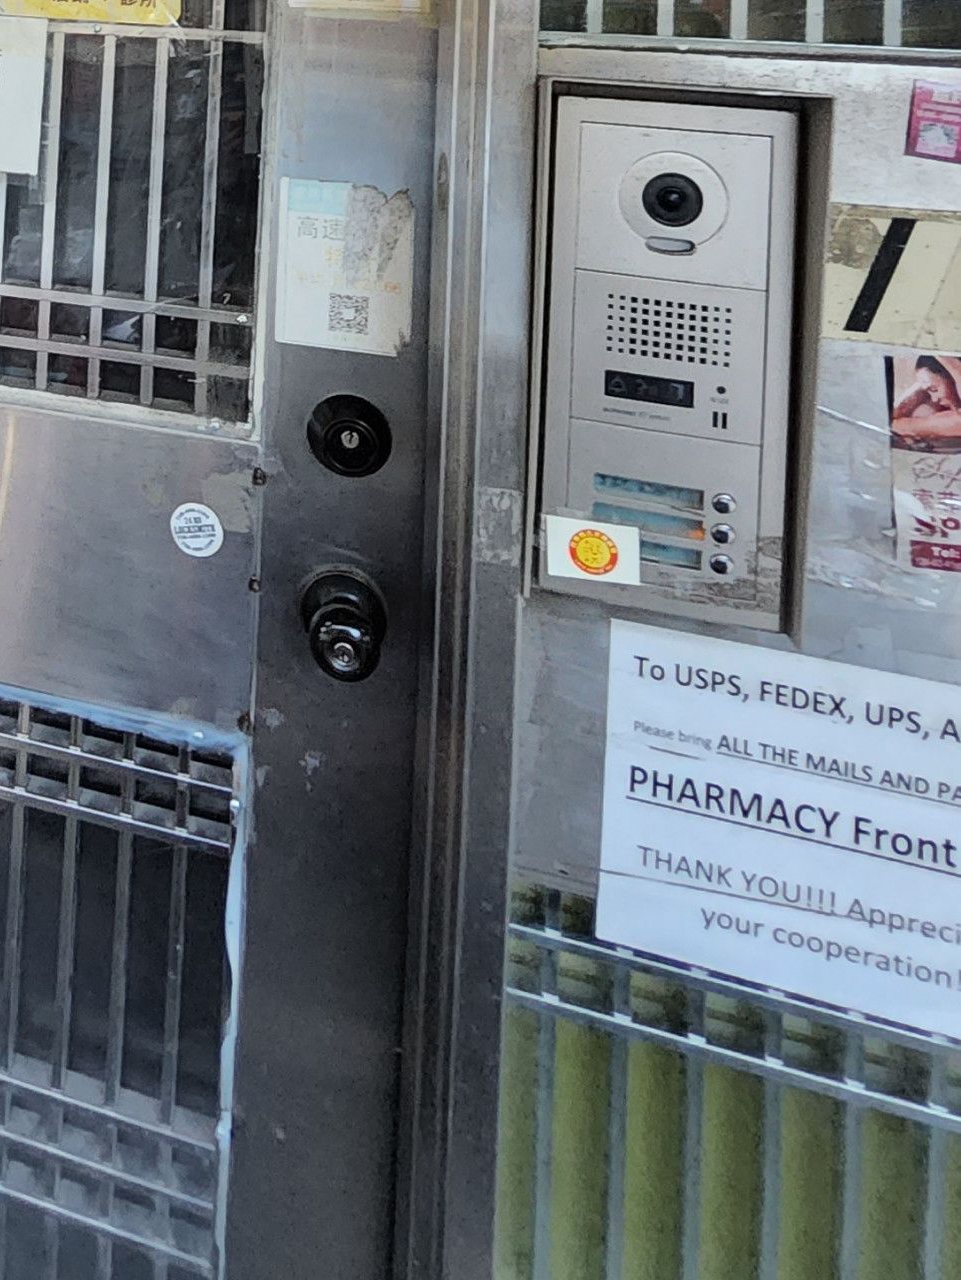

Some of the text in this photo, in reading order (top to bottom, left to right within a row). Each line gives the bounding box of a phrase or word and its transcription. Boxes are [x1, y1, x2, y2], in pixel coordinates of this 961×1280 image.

[633, 655, 665, 681] To
[674, 663, 750, 703] USPS,
[759, 680, 854, 725] FEDEX,
[864, 701, 930, 741] UPS,
[633, 720, 675, 741] Please
[678, 730, 713, 752] bring
[717, 734, 753, 757] ALL
[758, 741, 799, 767] THE
[805, 752, 873, 783] MAILS
[879, 769, 930, 795] AND
[629, 764, 958, 869] PHARMACY Front
[636, 844, 961, 946] THANK YOU!!! Appreci
[700, 907, 765, 938] your
